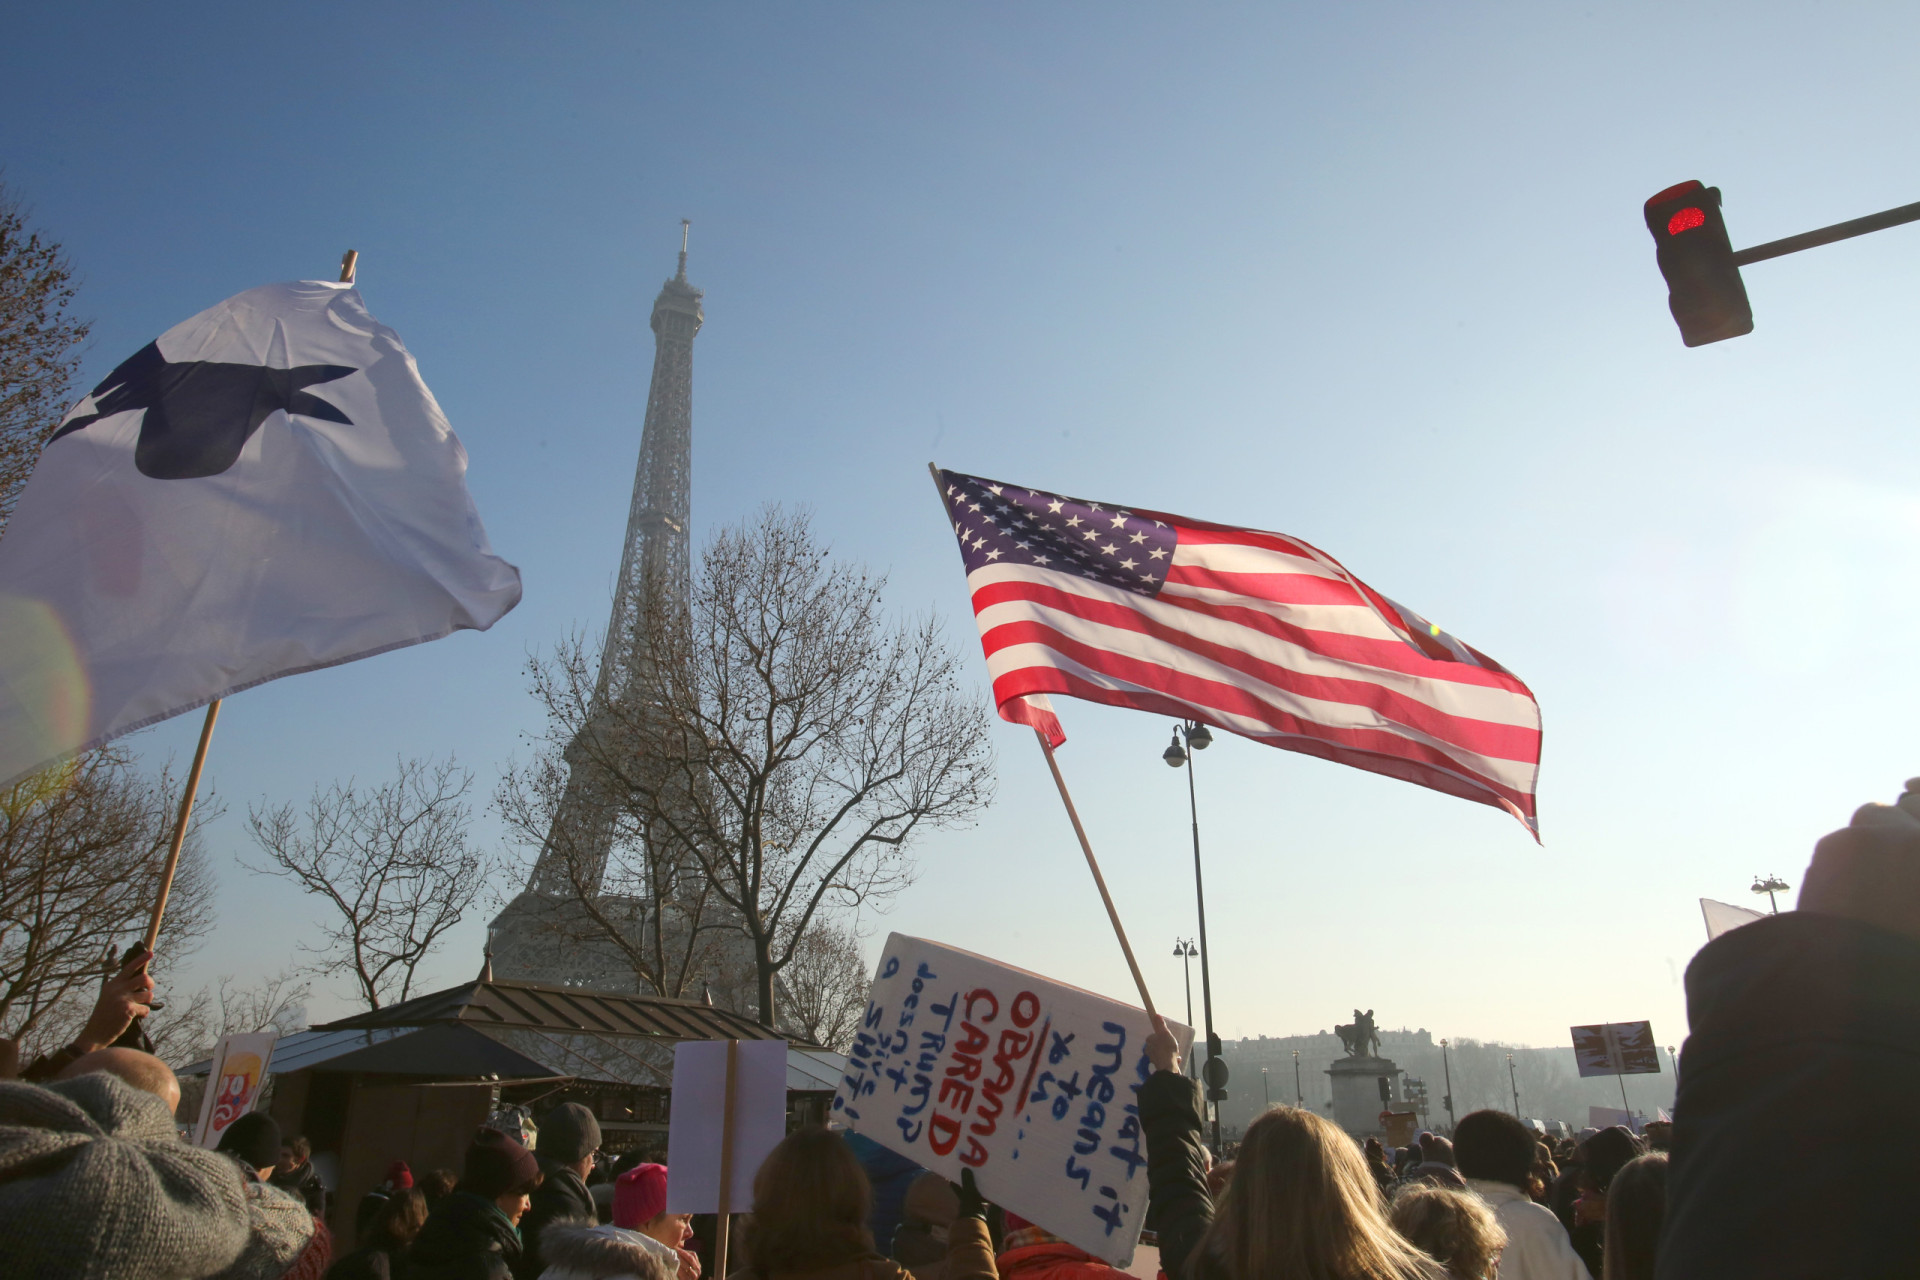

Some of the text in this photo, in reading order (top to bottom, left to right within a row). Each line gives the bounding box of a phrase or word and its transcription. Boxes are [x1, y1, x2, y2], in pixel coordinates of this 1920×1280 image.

[833, 956, 900, 1120] a SHIT!
[861, 1032, 893, 1097] give
[885, 962, 938, 1094] doesn't
[928, 987, 999, 1156] CARED
[958, 990, 1041, 1167] OBAMA
[1051, 1070, 1083, 1121] to
[1054, 1021, 1126, 1190] means
[1091, 1185, 1129, 1237] it
